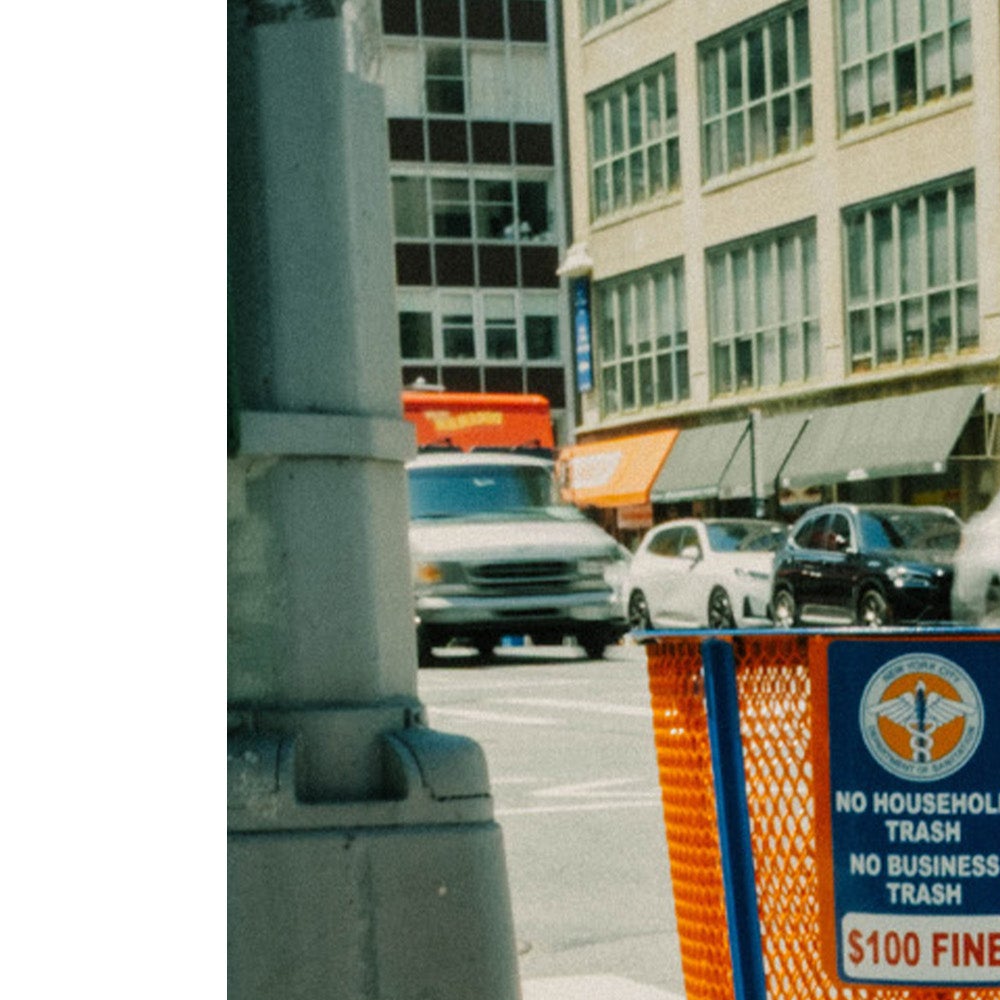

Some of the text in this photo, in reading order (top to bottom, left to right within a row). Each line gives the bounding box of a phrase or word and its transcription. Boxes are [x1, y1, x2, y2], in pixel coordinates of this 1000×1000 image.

[906, 660, 937, 672] YORK
[835, 790, 867, 814] NO
[885, 819, 962, 843] TRASH
[850, 853, 1000, 878] NO BUSINESS
[886, 882, 962, 906] TRASH
[847, 928, 921, 968] $100
